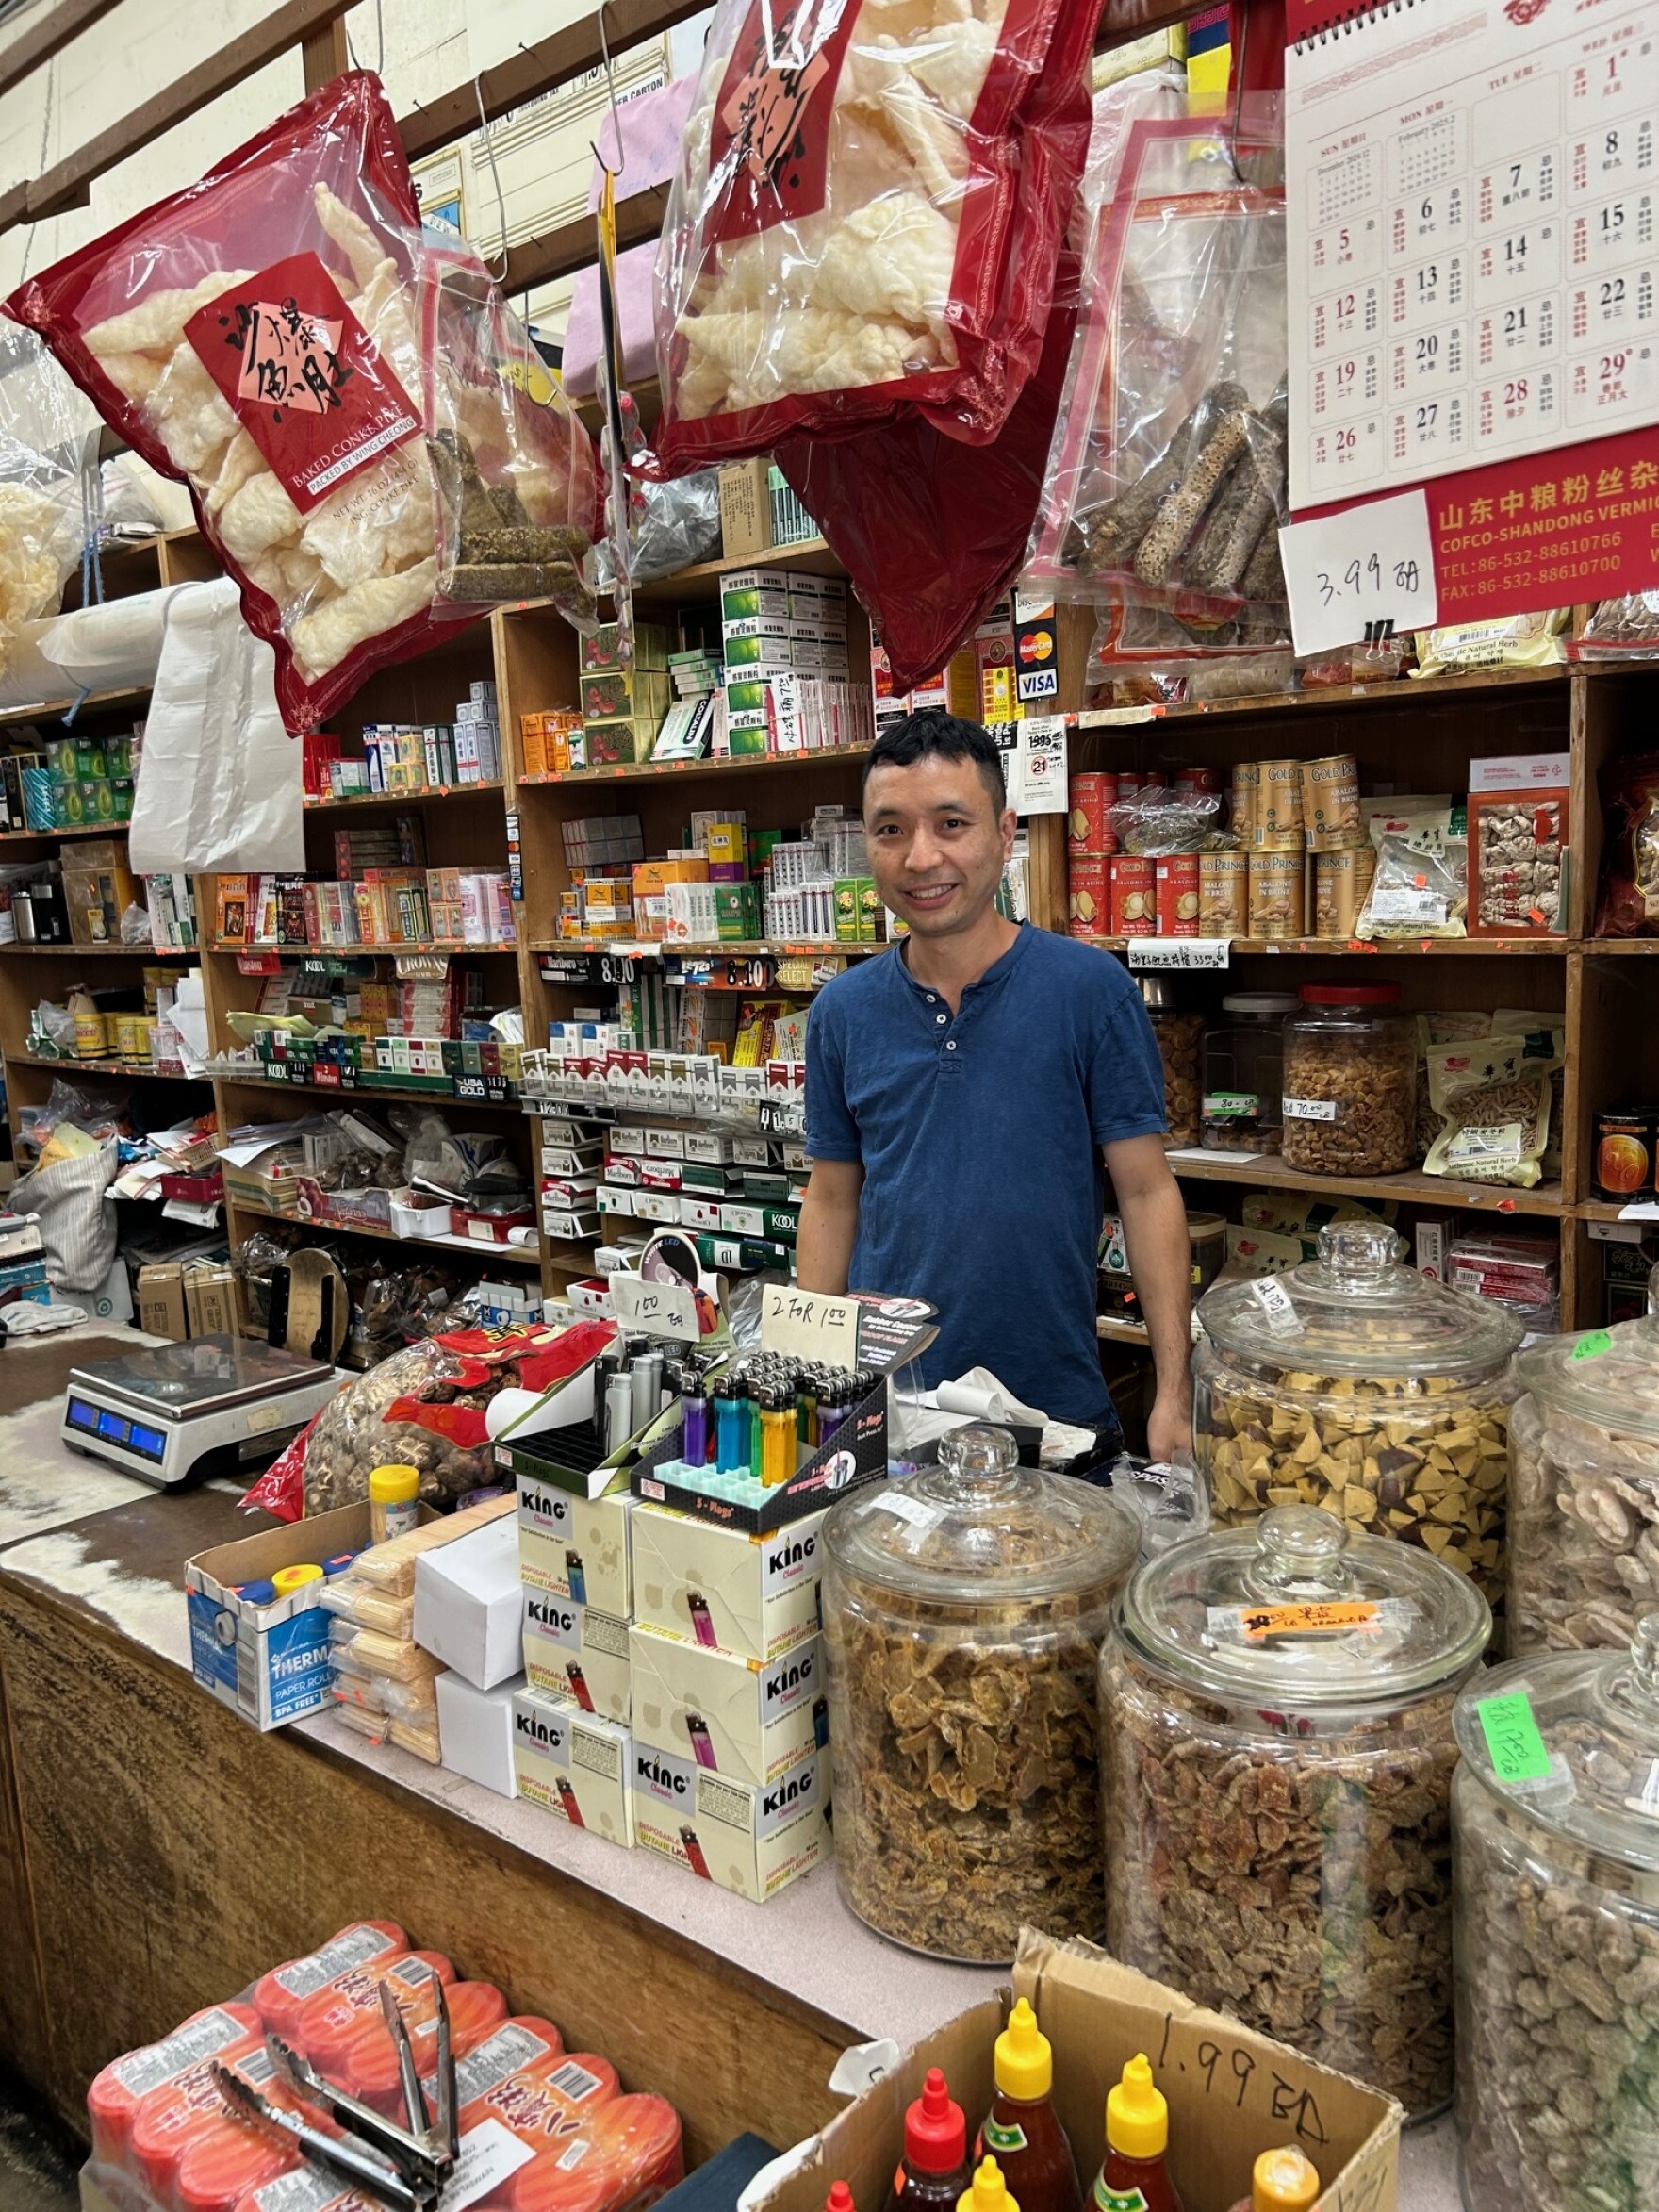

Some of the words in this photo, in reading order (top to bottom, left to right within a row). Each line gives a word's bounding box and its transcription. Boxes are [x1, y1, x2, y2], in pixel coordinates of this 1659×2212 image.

[1608, 56, 1617, 79] 1
[1400, 111, 1422, 124] MON
[1605, 131, 1618, 154] 8
[1510, 164, 1521, 188] 7
[1421, 196, 1433, 219] 6
[1600, 203, 1624, 231] 15
[1339, 228, 1350, 249] 5
[1504, 235, 1528, 261] 14
[1417, 266, 1437, 290] 13
[1600, 278, 1626, 305] 22
[1335, 294, 1355, 319] 12
[1504, 307, 1527, 333] 21
[1416, 335, 1437, 359] 20
[1335, 361, 1355, 385] 19
[1600, 354, 1626, 380] 29
[1504, 379, 1528, 404] 28
[1416, 404, 1437, 428] 27
[1335, 427, 1356, 450] 26
[292, 454, 331, 488] BAKED
[331, 423, 377, 457] CONKE
[310, 463, 341, 491] PACKED
[340, 456, 352, 470] BY
[352, 441, 378, 461] WING
[378, 417, 414, 445] CHEONG
[333, 504, 350, 520] NET
[1440, 509, 1595, 553] COFCO-SHANDONG
[1440, 531, 1622, 579] TEL:86-532-88610766
[1317, 553, 1382, 606] 3.99
[1441, 555, 1621, 602] FAX:86-532-88610700
[1498, 639, 1519, 649] Herb
[1023, 674, 1055, 694] VISA
[685, 700, 708, 741] COLTALIN
[1268, 768, 1295, 784] GOLD
[1311, 767, 1339, 784] GOLD
[1215, 858, 1249, 872] PRINCE
[1258, 880, 1292, 888] ABALONE
[305, 960, 325, 972] KOOL
[396, 954, 449, 975] CROWNS
[547, 955, 577, 969] Marlboro
[777, 958, 810, 970] SPECIAL
[778, 970, 806, 982] SELECT
[268, 1063, 288, 1079] KOOL
[460, 1086, 485, 1096] GOLD
[463, 1078, 484, 1087] USA
[608, 1167, 632, 1179] Marlboro
[646, 1165, 675, 1177] Marlboro
[1476, 1159, 1499, 1167] Natural
[545, 1192, 568, 1202] Marlboro
[771, 1213, 798, 1229] KOOL
[644, 1238, 664, 1264] WHITE
[664, 1237, 681, 1246] LED
[772, 1296, 784, 1316] 2
[789, 1297, 814, 1323] FOR
[534, 1513, 555, 1527] Classic
[521, 1564, 552, 1580] DISPOSABLE
[783, 1564, 804, 1579] Classic
[521, 1573, 544, 1587] BUTANE
[545, 1579, 569, 1594] LIGHTER
[539, 1624, 560, 1637] Classic
[636, 1622, 683, 1641] BUTANE
[683, 1636, 733, 1657] LIGHTER
[768, 1624, 800, 1648] DISPOSABLE
[768, 1638, 791, 1659] BUTANE
[792, 1622, 817, 1643] LIGHTER
[530, 1662, 567, 1682] DISPOSABLE
[530, 1671, 558, 1690] BUTANE
[275, 1681, 306, 1701] PAPER
[780, 1686, 801, 1705] Classic
[274, 1705, 294, 1717] BPA
[529, 1738, 549, 1752] Classic
[767, 1745, 799, 1773] DISPOSABLE
[766, 1761, 790, 1785] BUTANE
[520, 1775, 556, 1795] DISPOSABLE
[520, 1784, 549, 1800] BUTANE
[650, 1782, 673, 1800] Classic
[778, 1799, 800, 1820] Classic
[638, 1831, 670, 1852] BUTANE
[639, 1822, 680, 1844] DISPOSABLE
[766, 1852, 800, 1881] DISPOSABLE
[766, 1868, 791, 1892] BUTANE
[792, 1848, 818, 1873] LIGHTER
[1159, 2011, 1256, 2106] 1.99
